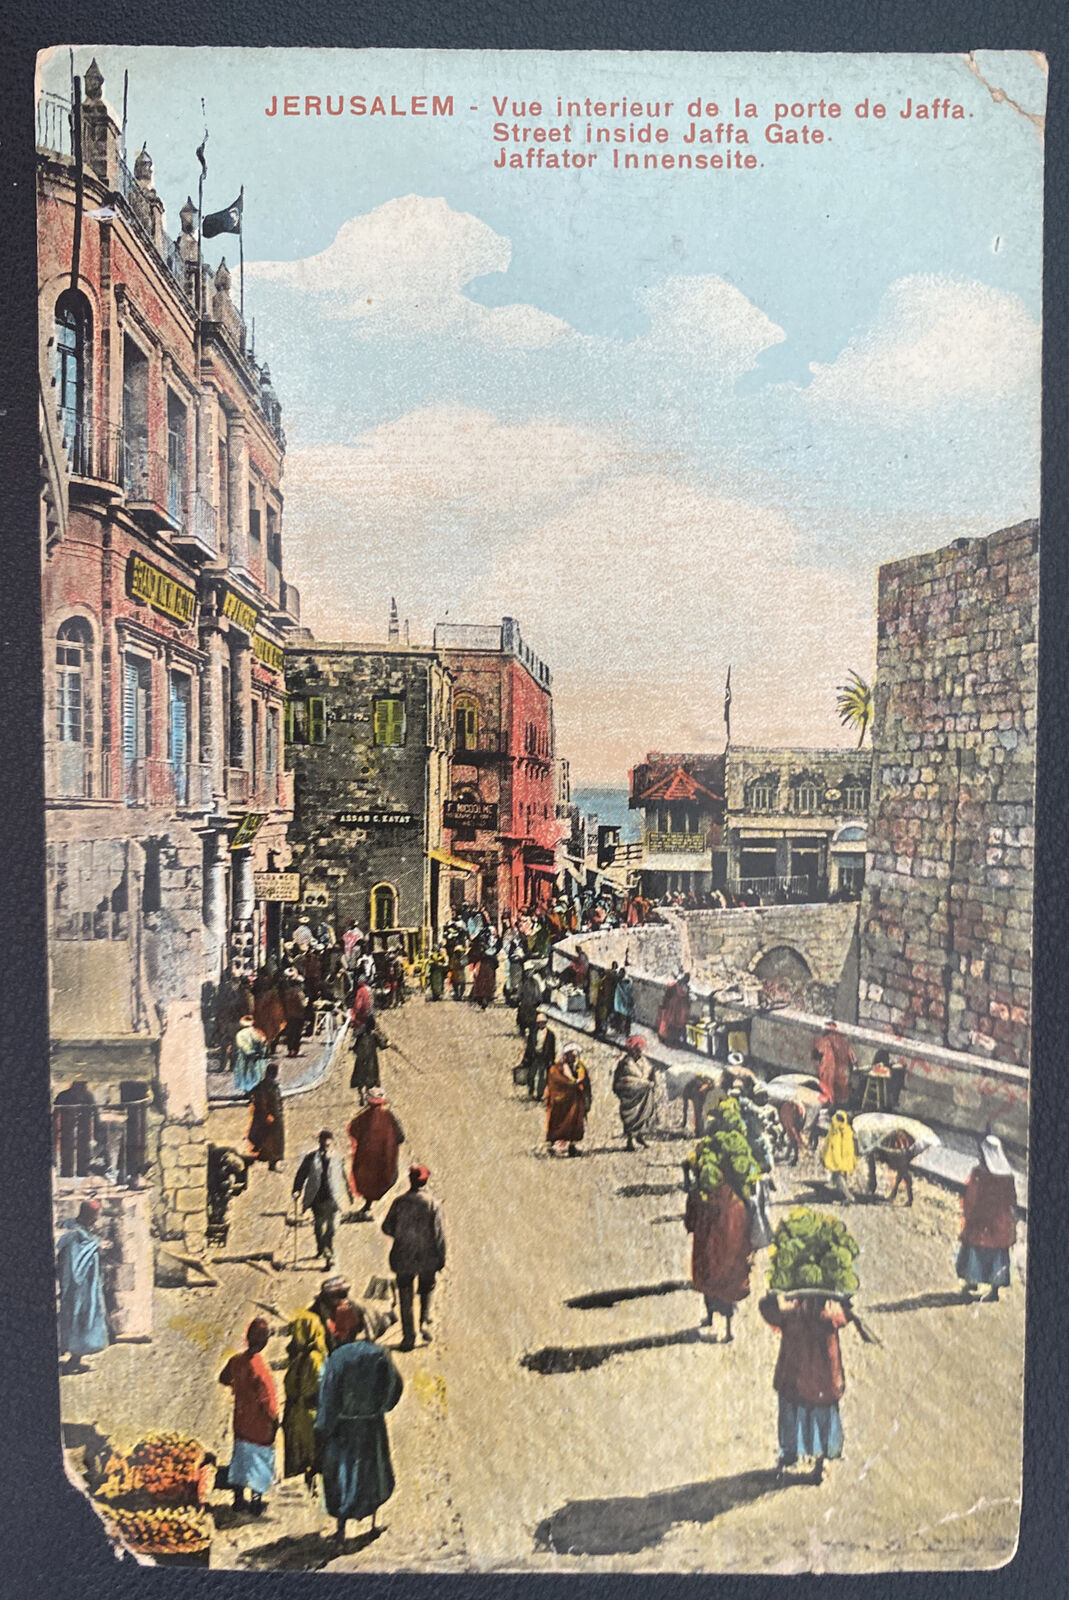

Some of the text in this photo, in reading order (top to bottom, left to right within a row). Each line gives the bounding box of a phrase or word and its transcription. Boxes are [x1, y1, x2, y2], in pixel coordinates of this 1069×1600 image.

[264, 95, 454, 117] JERUSALEM
[492, 96, 542, 117] Vue
[556, 96, 674, 118] interieur
[687, 97, 720, 118] de
[734, 97, 758, 118] la
[774, 98, 842, 121] porte
[854, 98, 887, 119] de
[899, 98, 974, 120] Jaffa.
[493, 121, 833, 144] Street inside Jaffa Gate.
[494, 147, 764, 170] Jaffator Innenseite.
